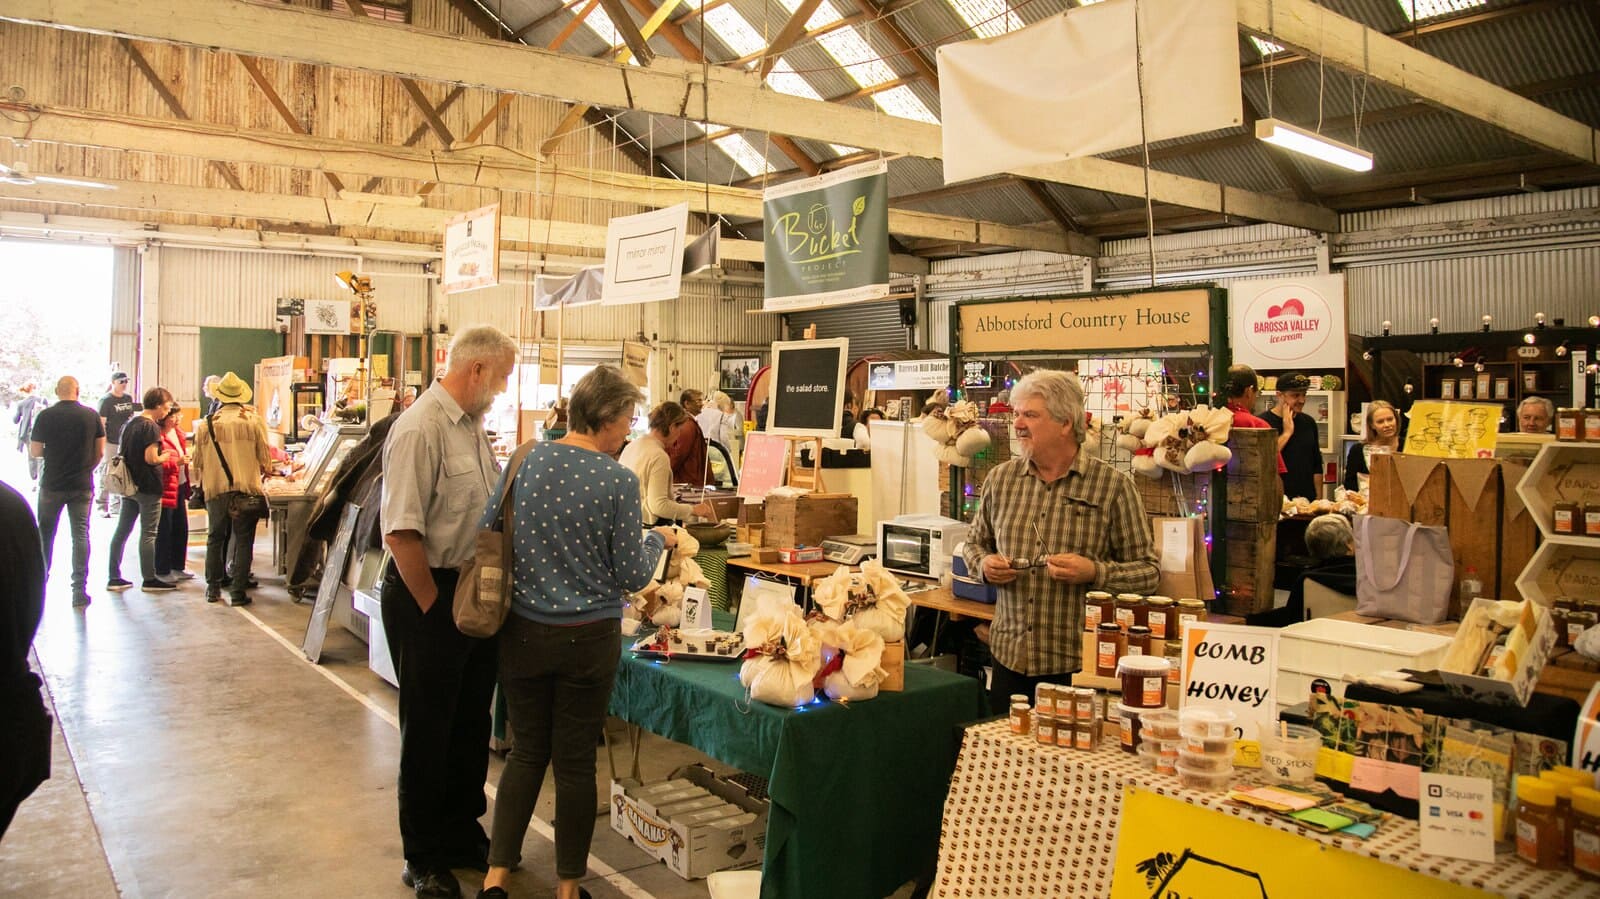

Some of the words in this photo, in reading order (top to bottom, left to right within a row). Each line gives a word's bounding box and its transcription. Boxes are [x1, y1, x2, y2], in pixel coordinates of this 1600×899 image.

[975, 312, 1052, 332] Abbotsford
[1060, 311, 1127, 331] Country
[1136, 307, 1191, 326] House
[1254, 321, 1288, 333] BAROSSA
[1290, 319, 1320, 331] VALLEY
[785, 384, 796, 393] the
[796, 383, 813, 393] salad
[813, 384, 830, 393] store.
[1194, 641, 1265, 665] COMB
[1444, 787, 1485, 801] Square
[1446, 810, 1464, 818] VISA
[628, 806, 667, 843] BANANAS
